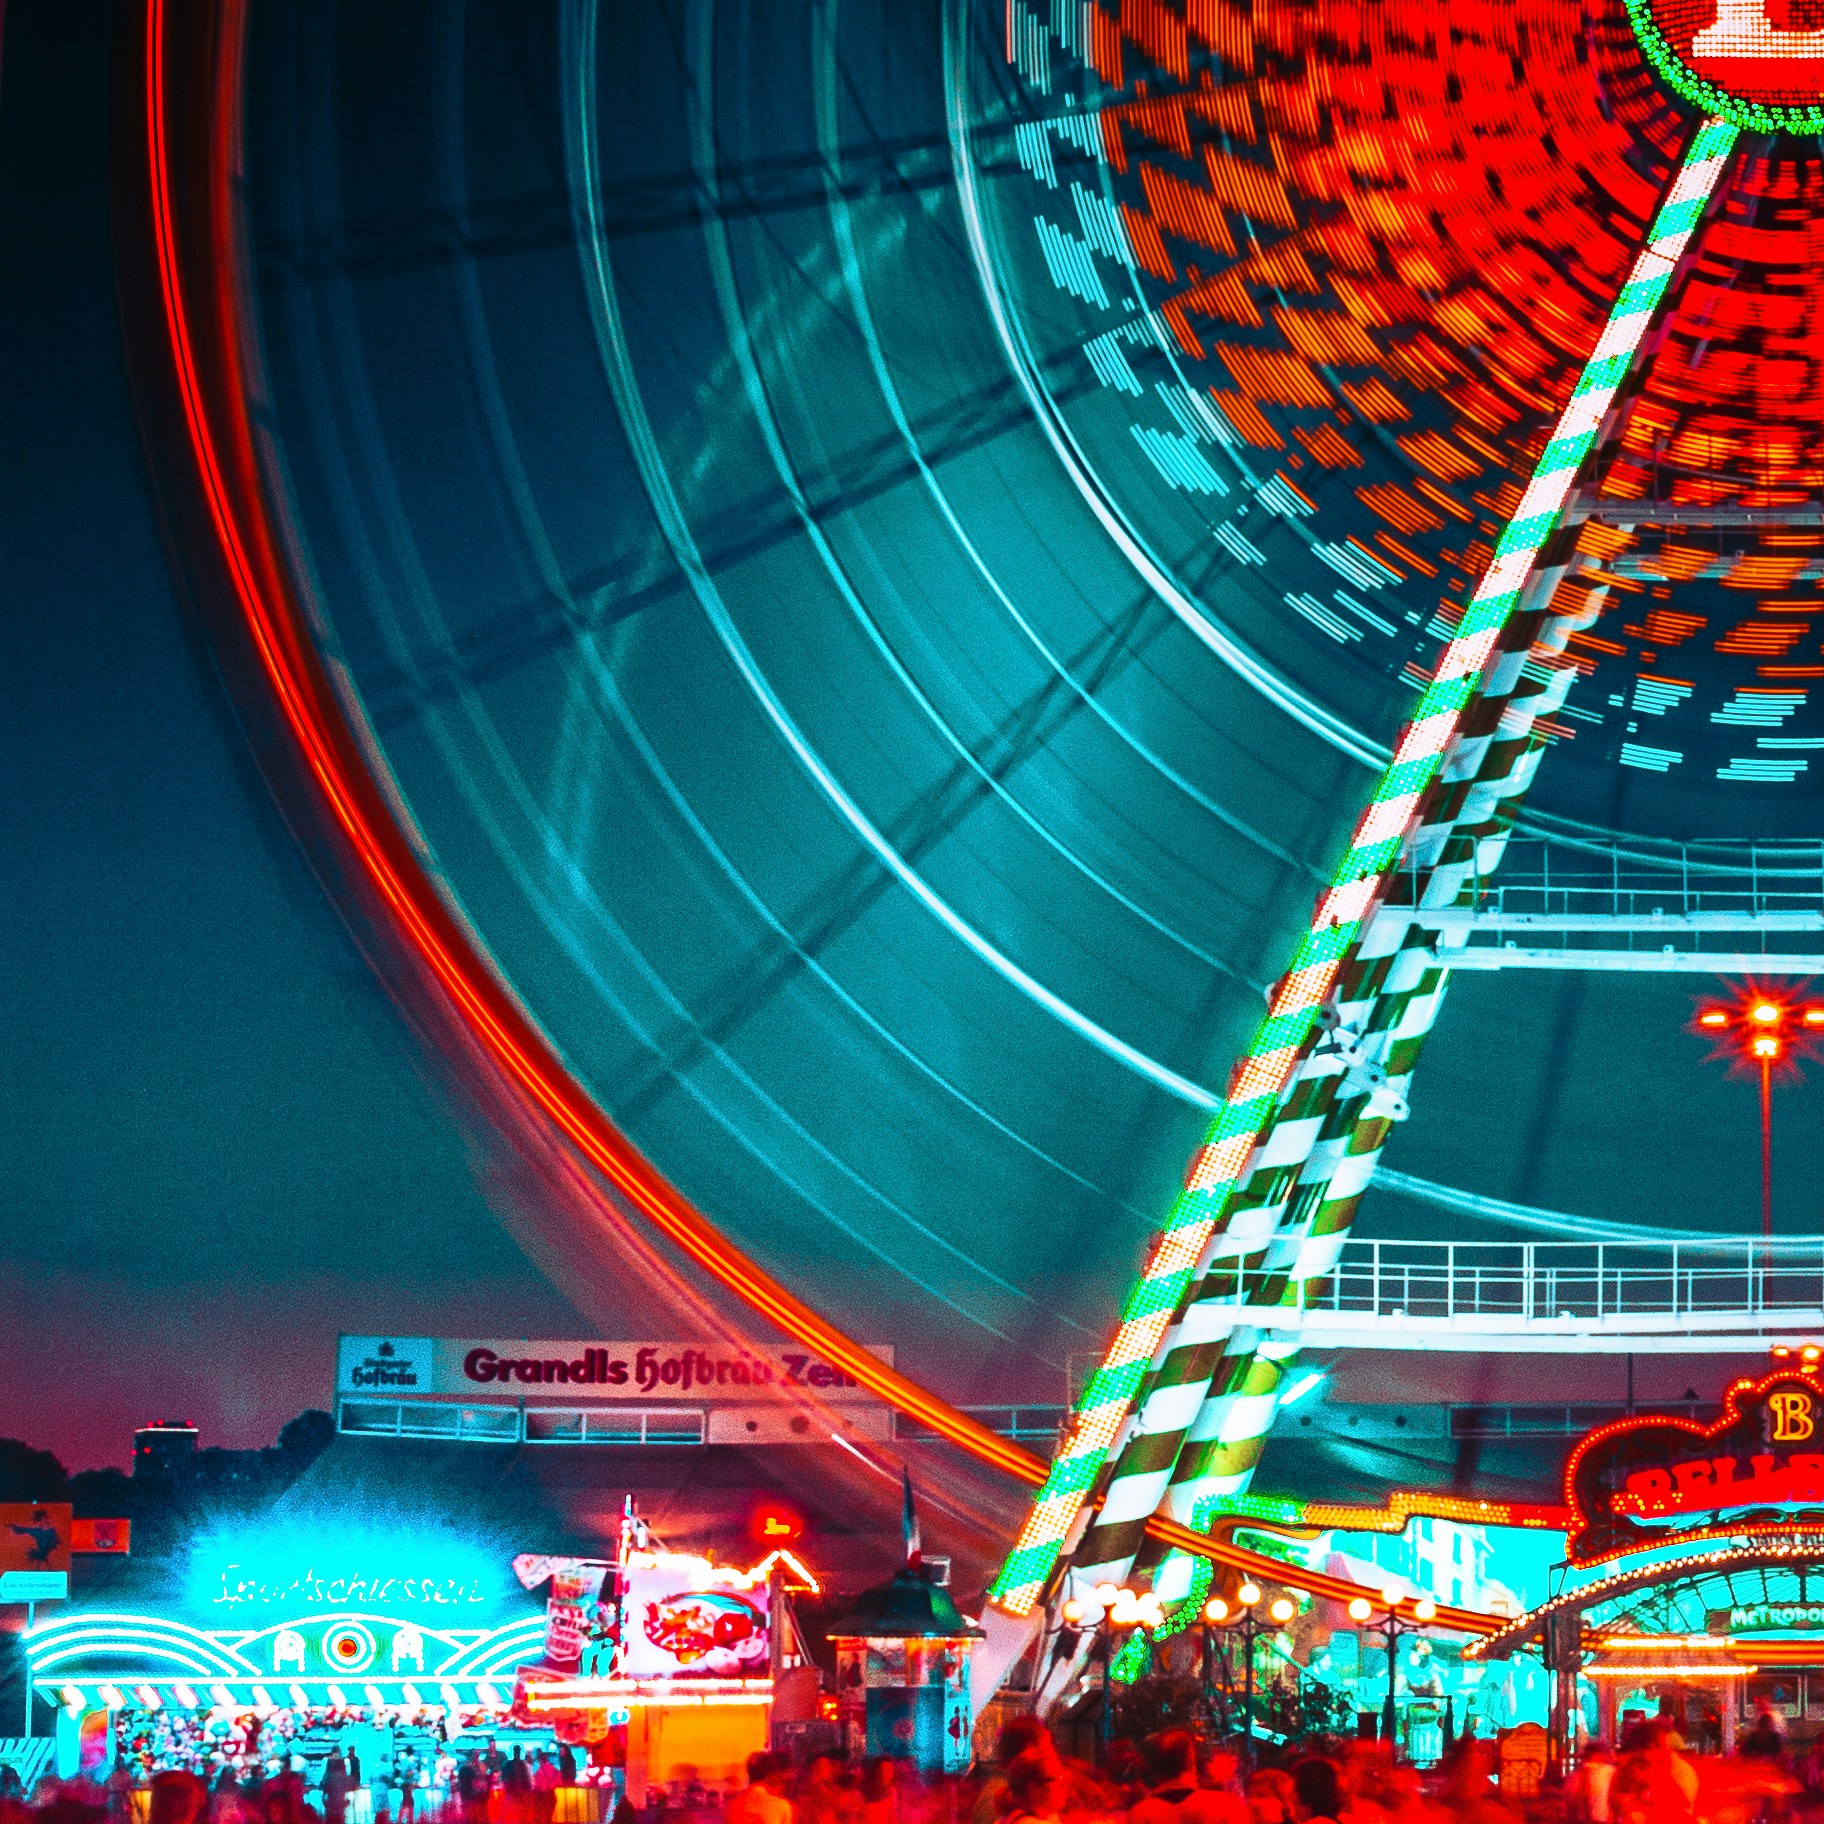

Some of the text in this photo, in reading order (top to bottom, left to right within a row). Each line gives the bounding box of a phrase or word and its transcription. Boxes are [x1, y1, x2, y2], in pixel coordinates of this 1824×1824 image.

[463, 1347, 629, 1384] Grandls
[781, 1354, 859, 1388] Zel
[1768, 1391, 1815, 1441] B
